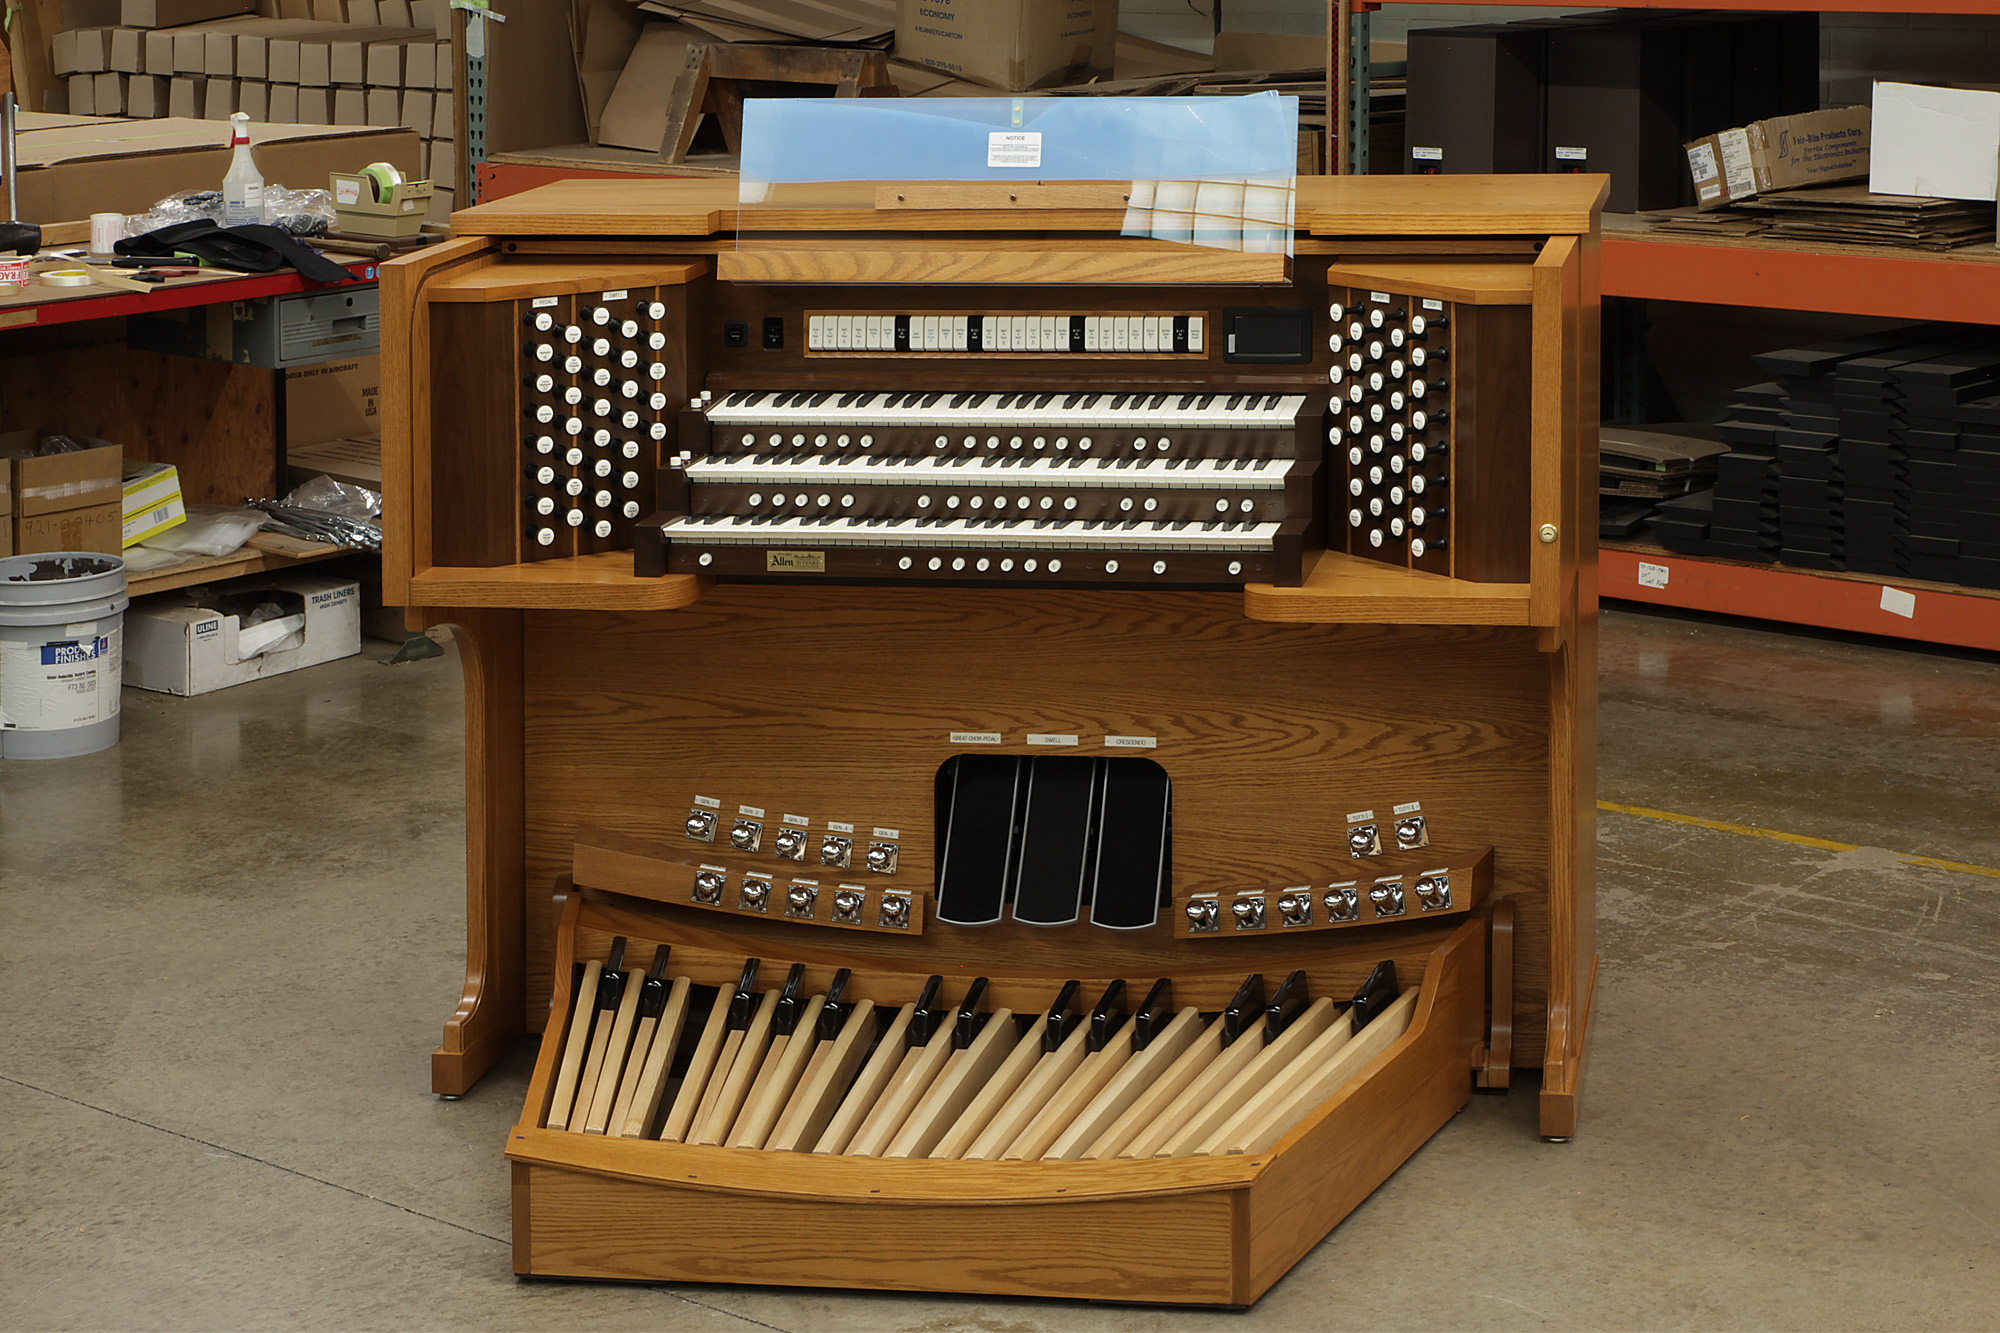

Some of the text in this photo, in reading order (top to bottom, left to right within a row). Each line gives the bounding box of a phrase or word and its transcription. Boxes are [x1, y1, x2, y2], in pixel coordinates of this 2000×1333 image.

[920, 8, 955, 21] ECONOMY
[1793, 128, 1864, 145] Fair-Rite Products Corp.
[1824, 141, 1857, 151] Components
[1791, 157, 1800, 166] for
[1813, 150, 1843, 161] Electronics
[304, 369, 319, 377] ONLY
[329, 363, 359, 373] AIRCRAFT
[362, 386, 379, 397] MADE
[368, 399, 374, 407] IN
[365, 407, 377, 417] USA
[771, 554, 795, 567] Allen
[311, 587, 355, 604] TRASH LINERS
[331, 598, 347, 607] DENSITY
[197, 621, 217, 633] ULINE
[55, 643, 96, 656] PRODT
